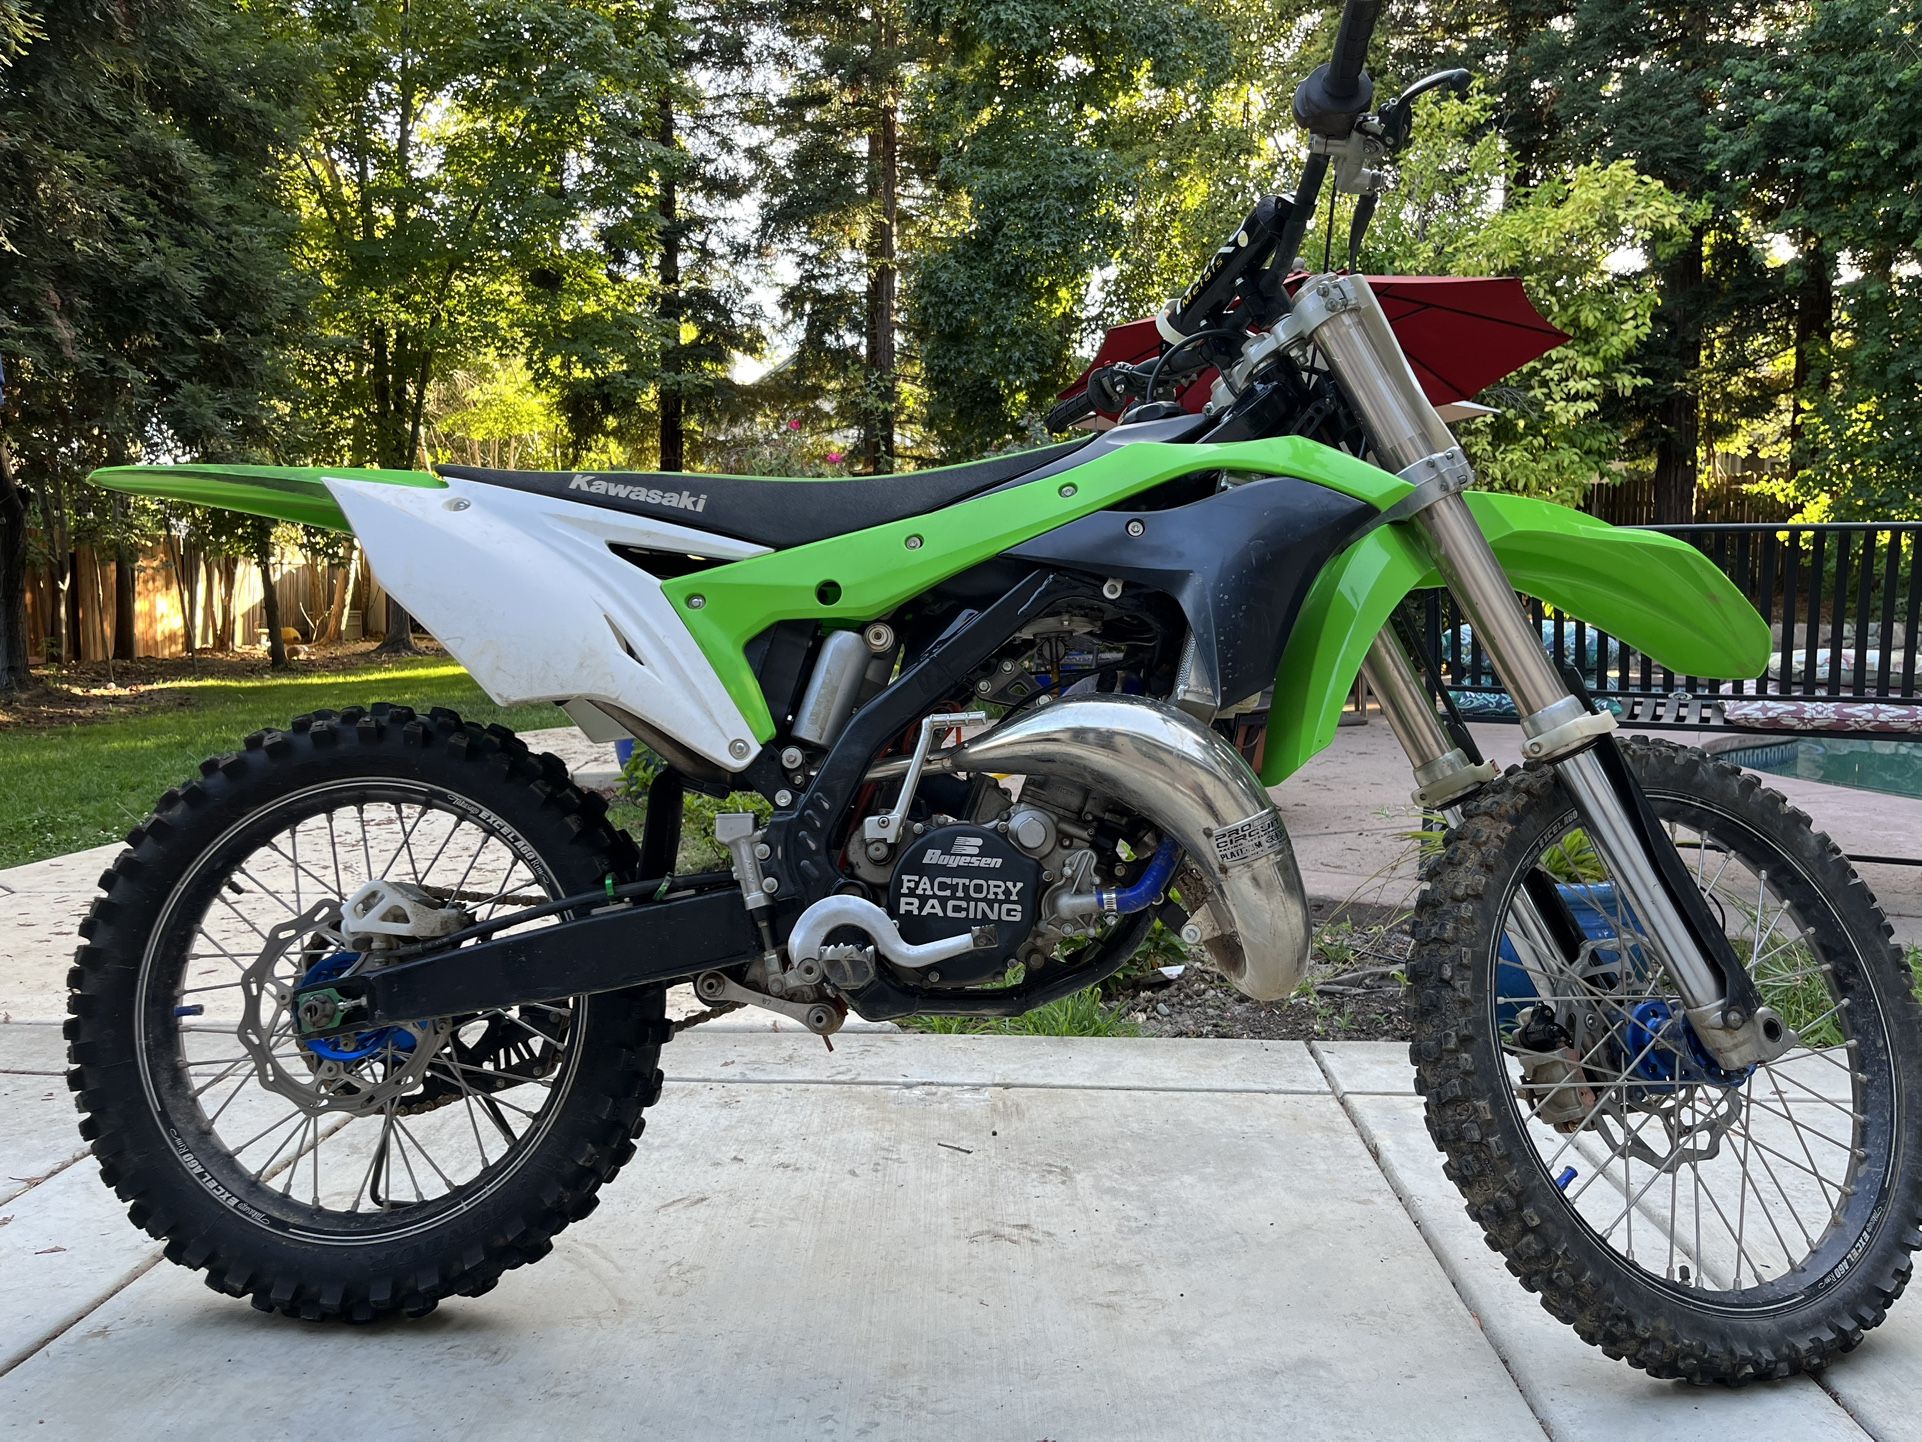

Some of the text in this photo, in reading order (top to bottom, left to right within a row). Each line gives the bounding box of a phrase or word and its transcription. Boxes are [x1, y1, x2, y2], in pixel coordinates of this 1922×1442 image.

[568, 474, 708, 512] Kawasaki
[478, 810, 516, 842] EXCEL
[514, 841, 535, 860] A60
[1214, 822, 1252, 842] PRO
[1216, 818, 1280, 849] CIRCUIT
[1538, 822, 1564, 849] EXCEL
[922, 849, 1003, 868] Boyesen
[1219, 840, 1263, 861] PLATIM
[900, 874, 1024, 901] FACTORY
[899, 897, 1022, 922] RACING
[182, 1153, 205, 1174] A60
[201, 1172, 240, 1207] EXCEL
[1846, 1230, 1870, 1263] EXCEL
[1834, 1259, 1850, 1279] A60
